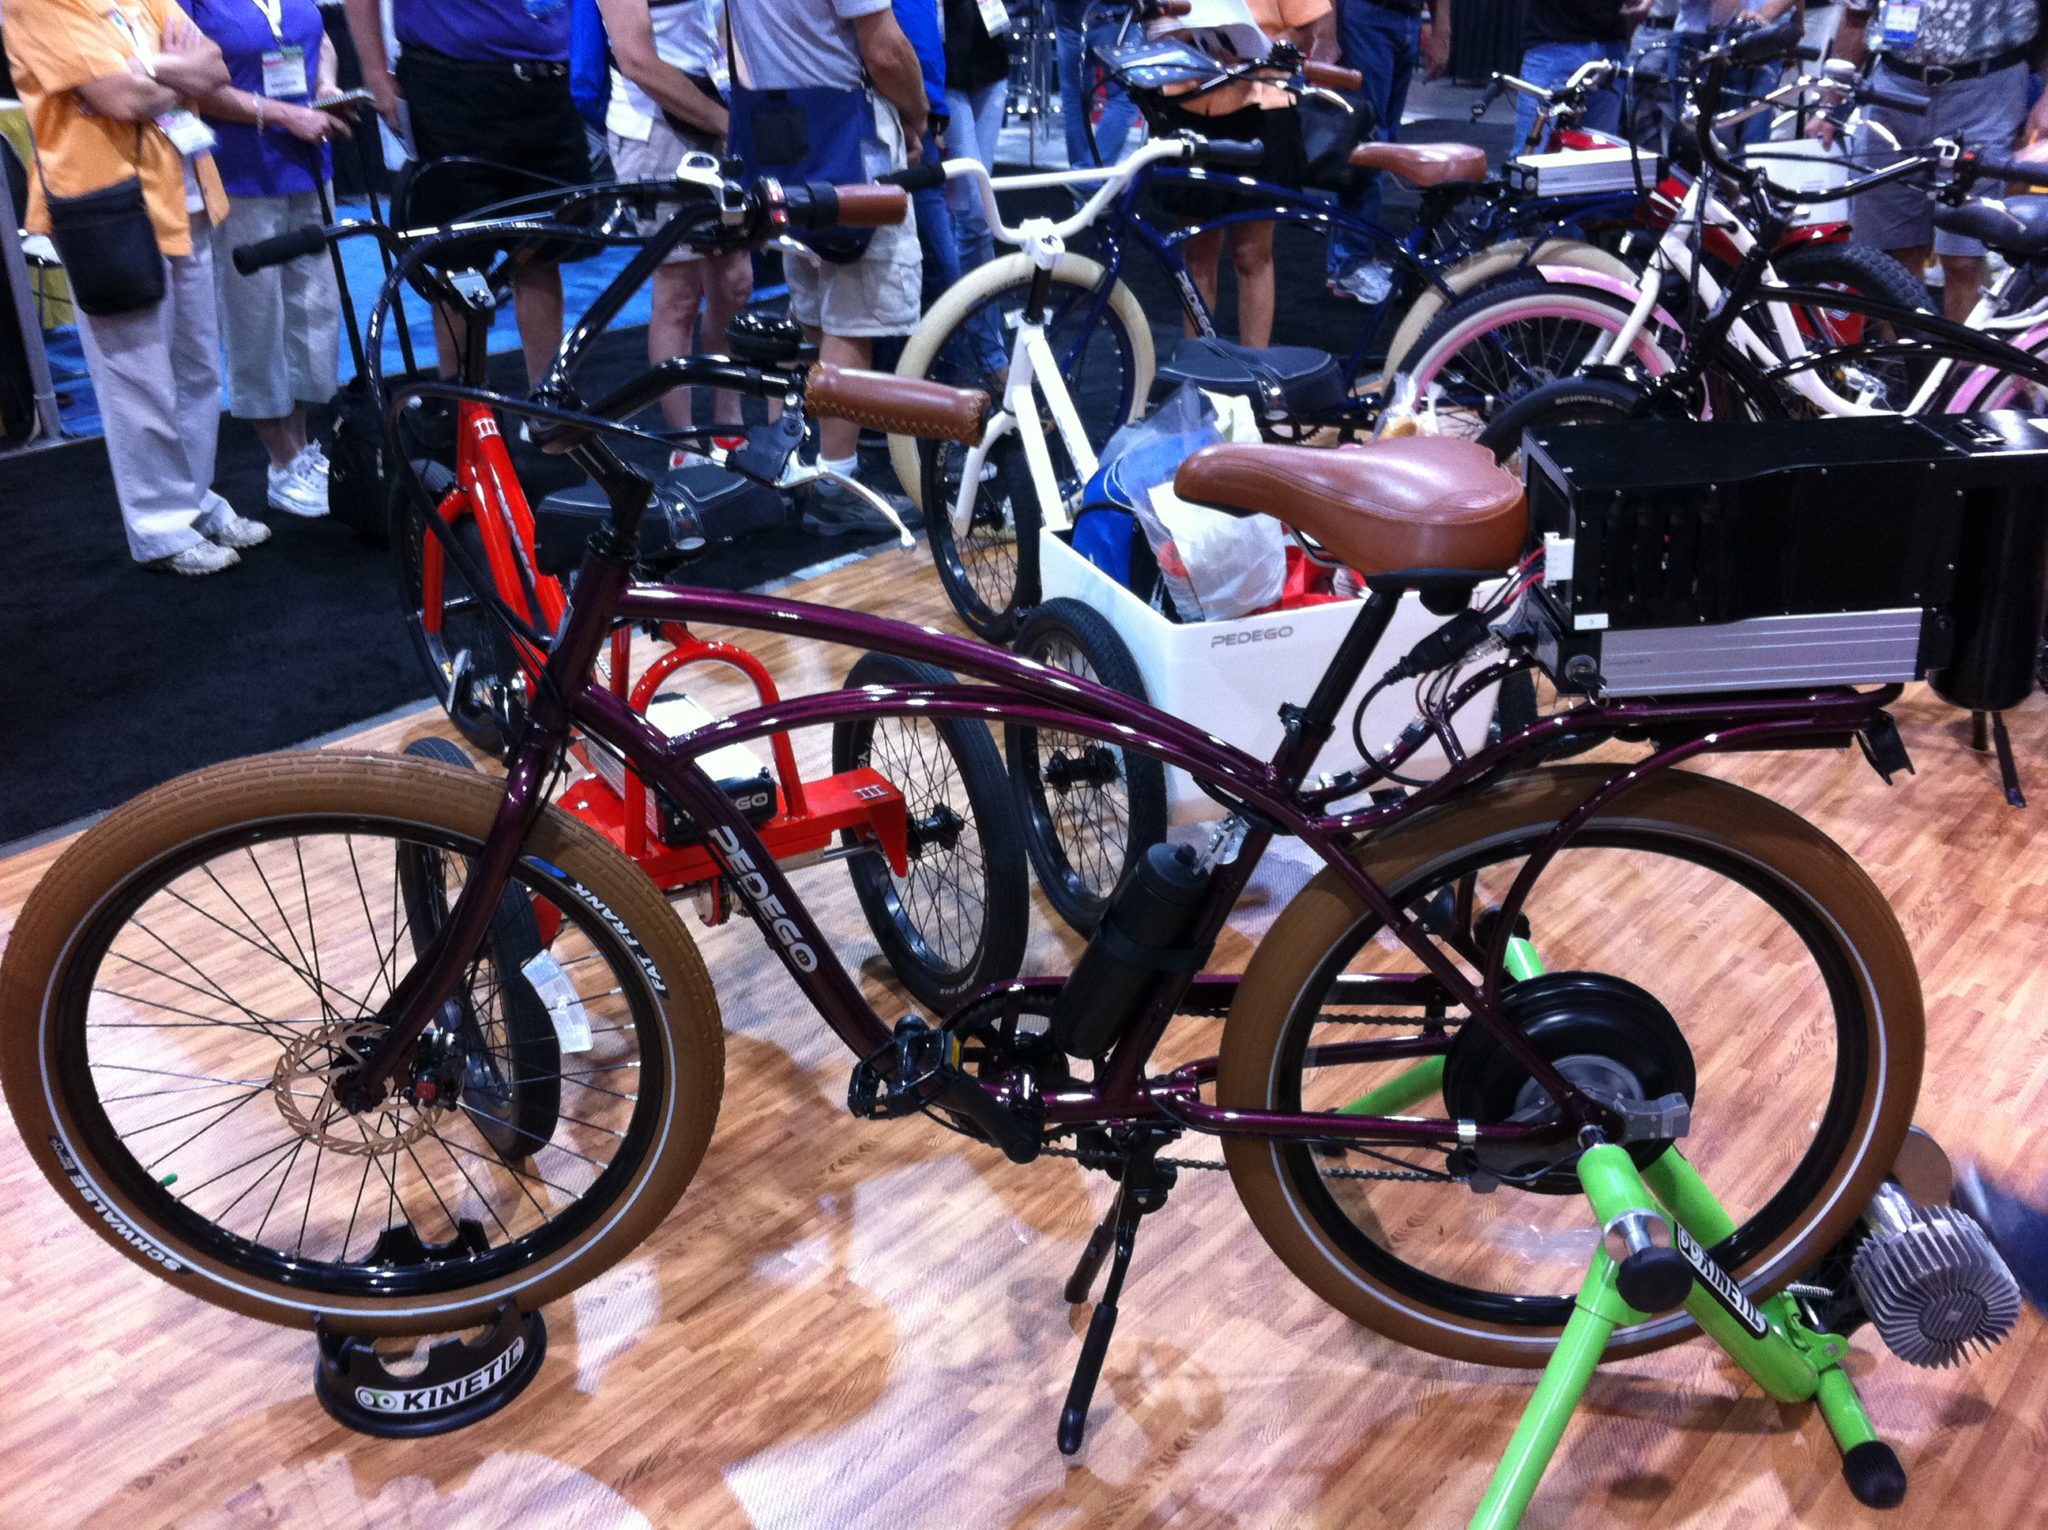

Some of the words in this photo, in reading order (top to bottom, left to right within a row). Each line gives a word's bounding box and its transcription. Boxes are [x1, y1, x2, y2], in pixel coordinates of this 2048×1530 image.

[1211, 626, 1294, 648] PEDEGO
[569, 882, 639, 946] FRANK
[707, 825, 818, 973] PEDEGO
[637, 954, 667, 991] FAT
[69, 1174, 182, 1272] SCHWALBE
[402, 1341, 521, 1412] KINETIC
